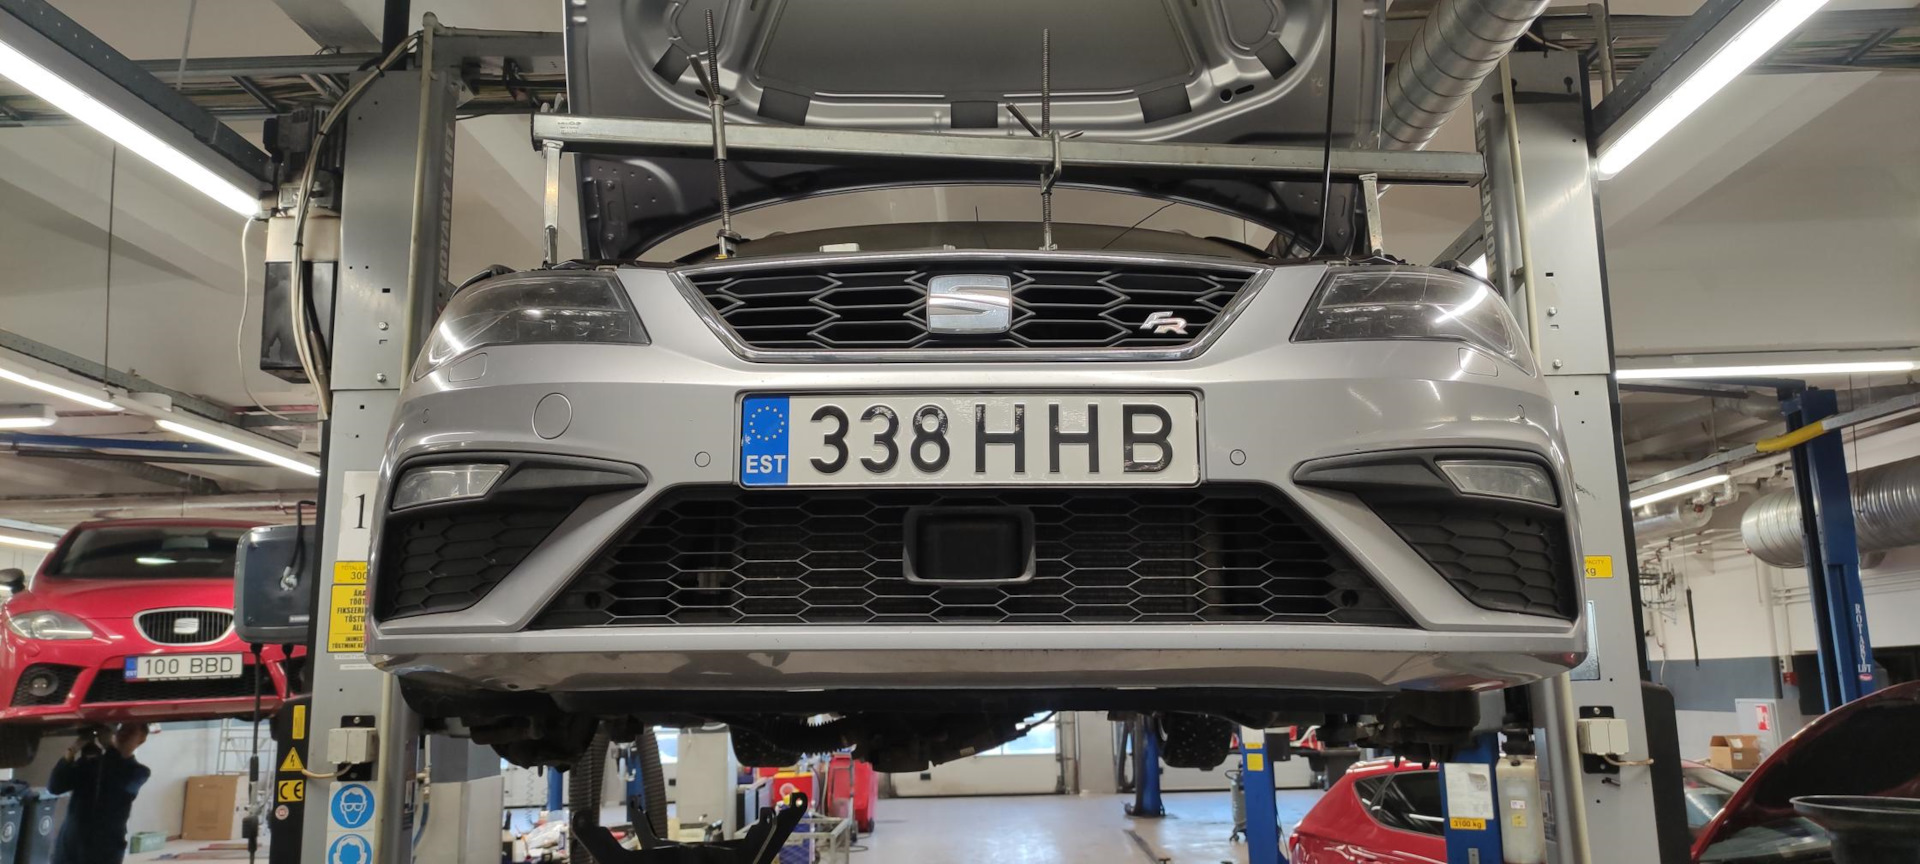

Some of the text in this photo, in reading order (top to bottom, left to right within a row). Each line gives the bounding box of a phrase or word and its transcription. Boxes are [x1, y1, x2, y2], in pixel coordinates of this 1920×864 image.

[438, 123, 454, 286] ROTARY LIFT
[1140, 310, 1188, 335] FR
[809, 403, 1173, 473] 338 HHB
[746, 454, 786, 474] EST
[353, 493, 367, 530] 1
[1854, 603, 1867, 664] ROTARY
[145, 656, 233, 676] 100 BBD
